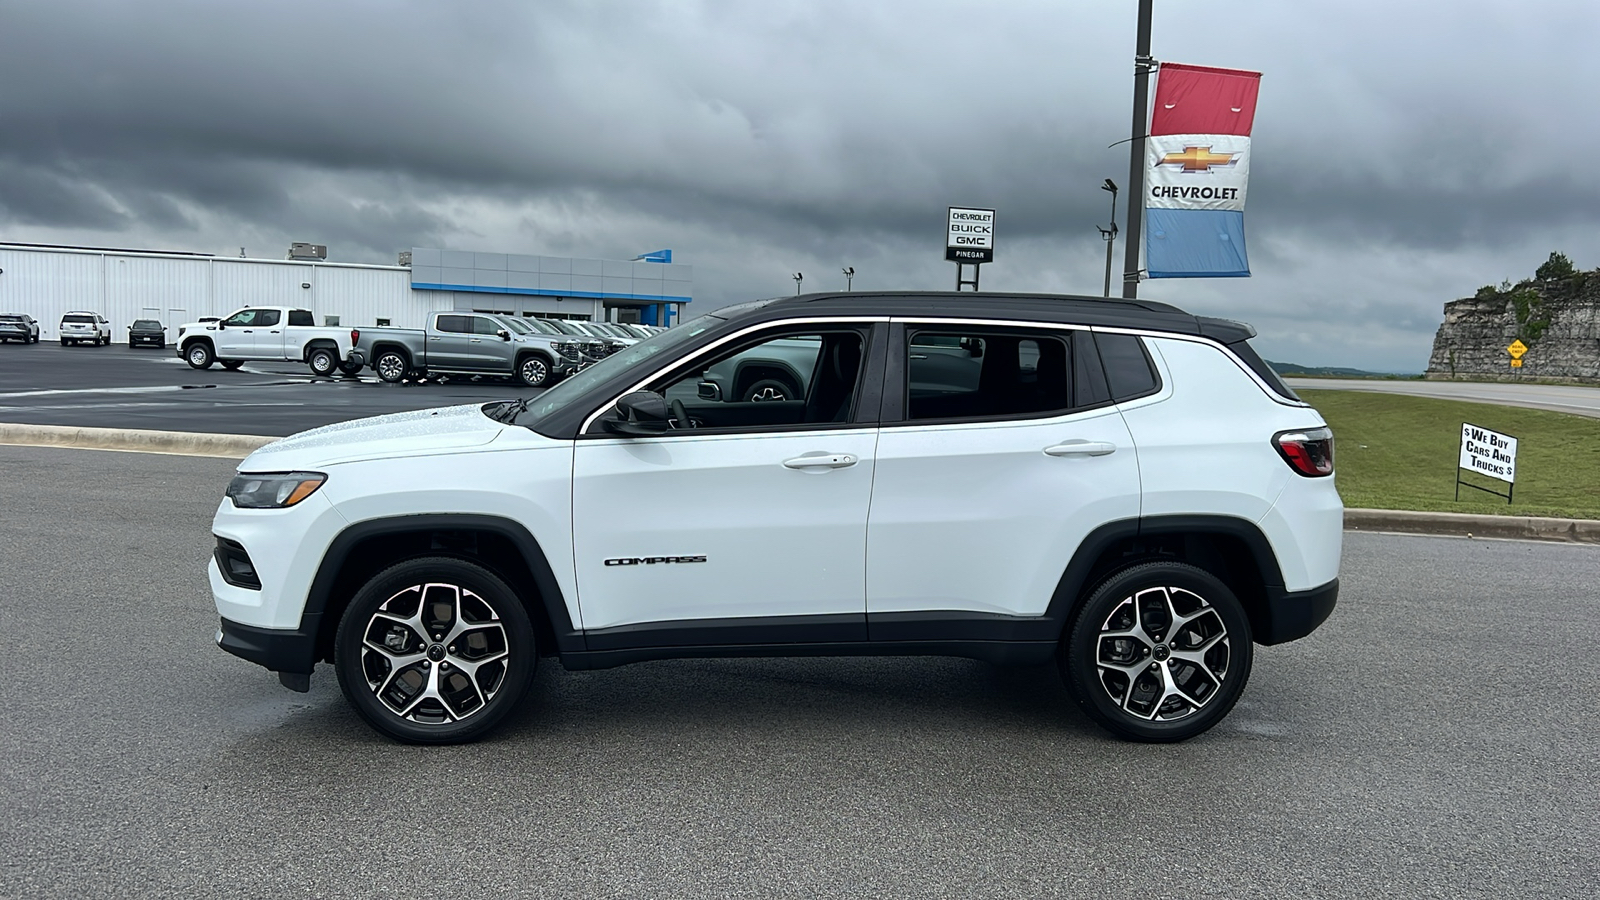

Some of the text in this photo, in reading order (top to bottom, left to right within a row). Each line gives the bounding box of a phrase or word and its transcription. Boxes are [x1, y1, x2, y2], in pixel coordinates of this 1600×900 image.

[1152, 186, 1238, 200] CHEVROLET
[953, 213, 991, 221] CHEVROLET
[952, 224, 990, 233] BUICK
[957, 236, 985, 245] GMC
[955, 250, 984, 258] PINEGAR
[1490, 434, 1509, 449] BUY
[1466, 441, 1511, 463] CARS AND
[1471, 455, 1504, 475] TRUCKS
[604, 555, 707, 566] COMPASS
